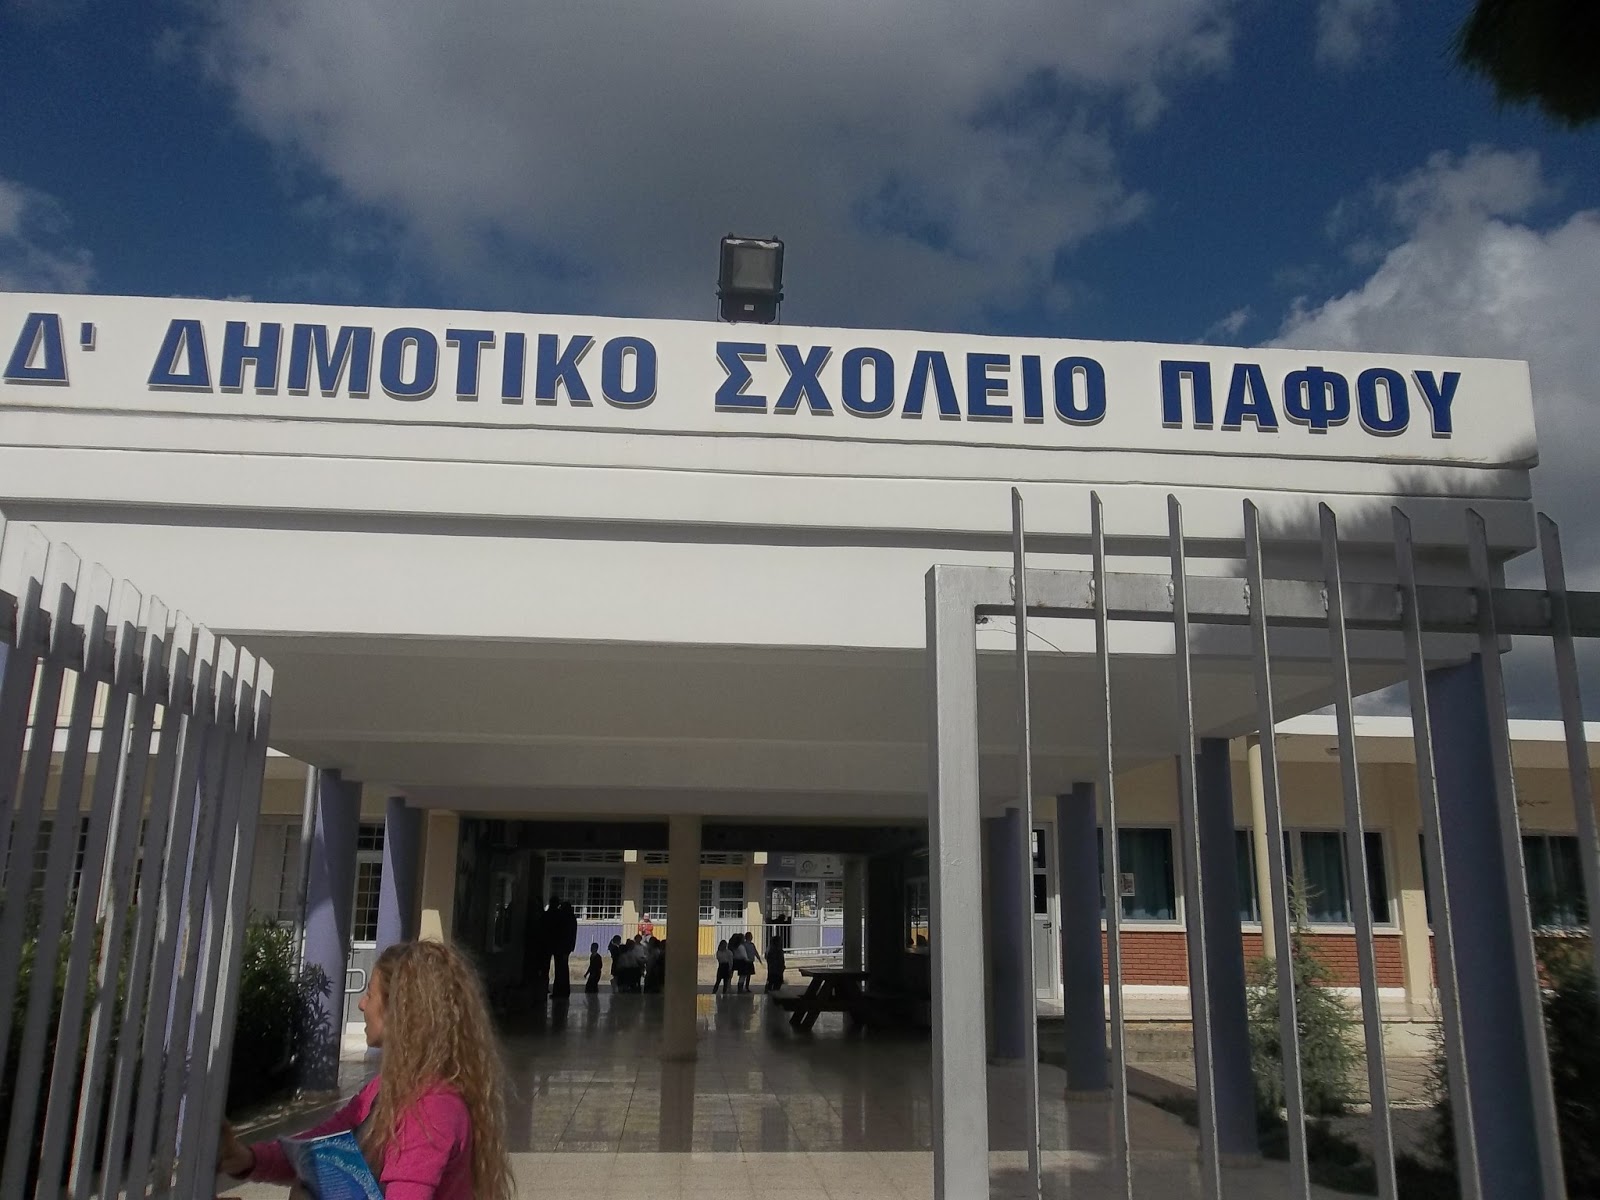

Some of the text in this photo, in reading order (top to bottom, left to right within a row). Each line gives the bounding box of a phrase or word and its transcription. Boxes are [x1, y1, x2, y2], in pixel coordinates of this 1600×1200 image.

[148, 319, 658, 405] ΔΗΜΟΤΙΚΟ
[715, 341, 1106, 423] ΣΧΟΛΕΙΟ
[1160, 361, 1461, 436] ΠΑΦΟΥ
